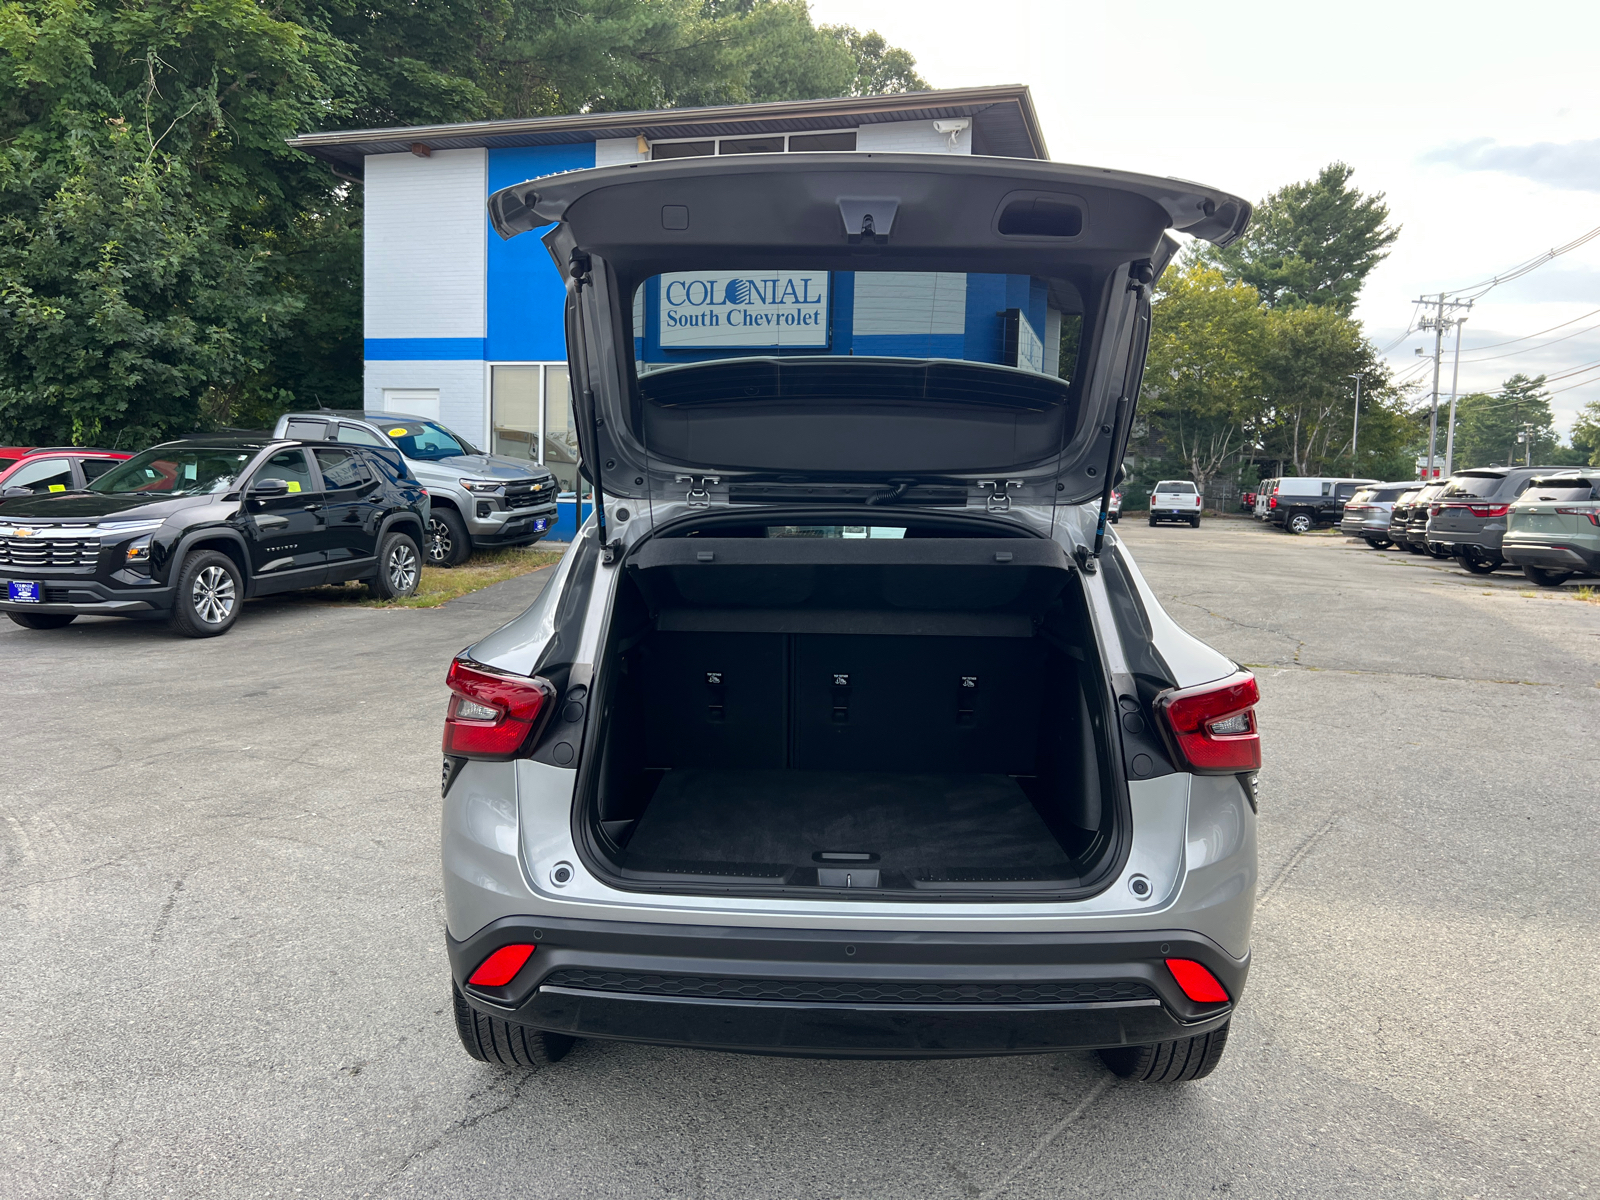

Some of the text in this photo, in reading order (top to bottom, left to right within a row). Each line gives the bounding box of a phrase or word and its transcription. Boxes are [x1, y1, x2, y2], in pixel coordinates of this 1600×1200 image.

[666, 278, 822, 306] COLONIAL
[666, 308, 821, 327] South Chevrolet
